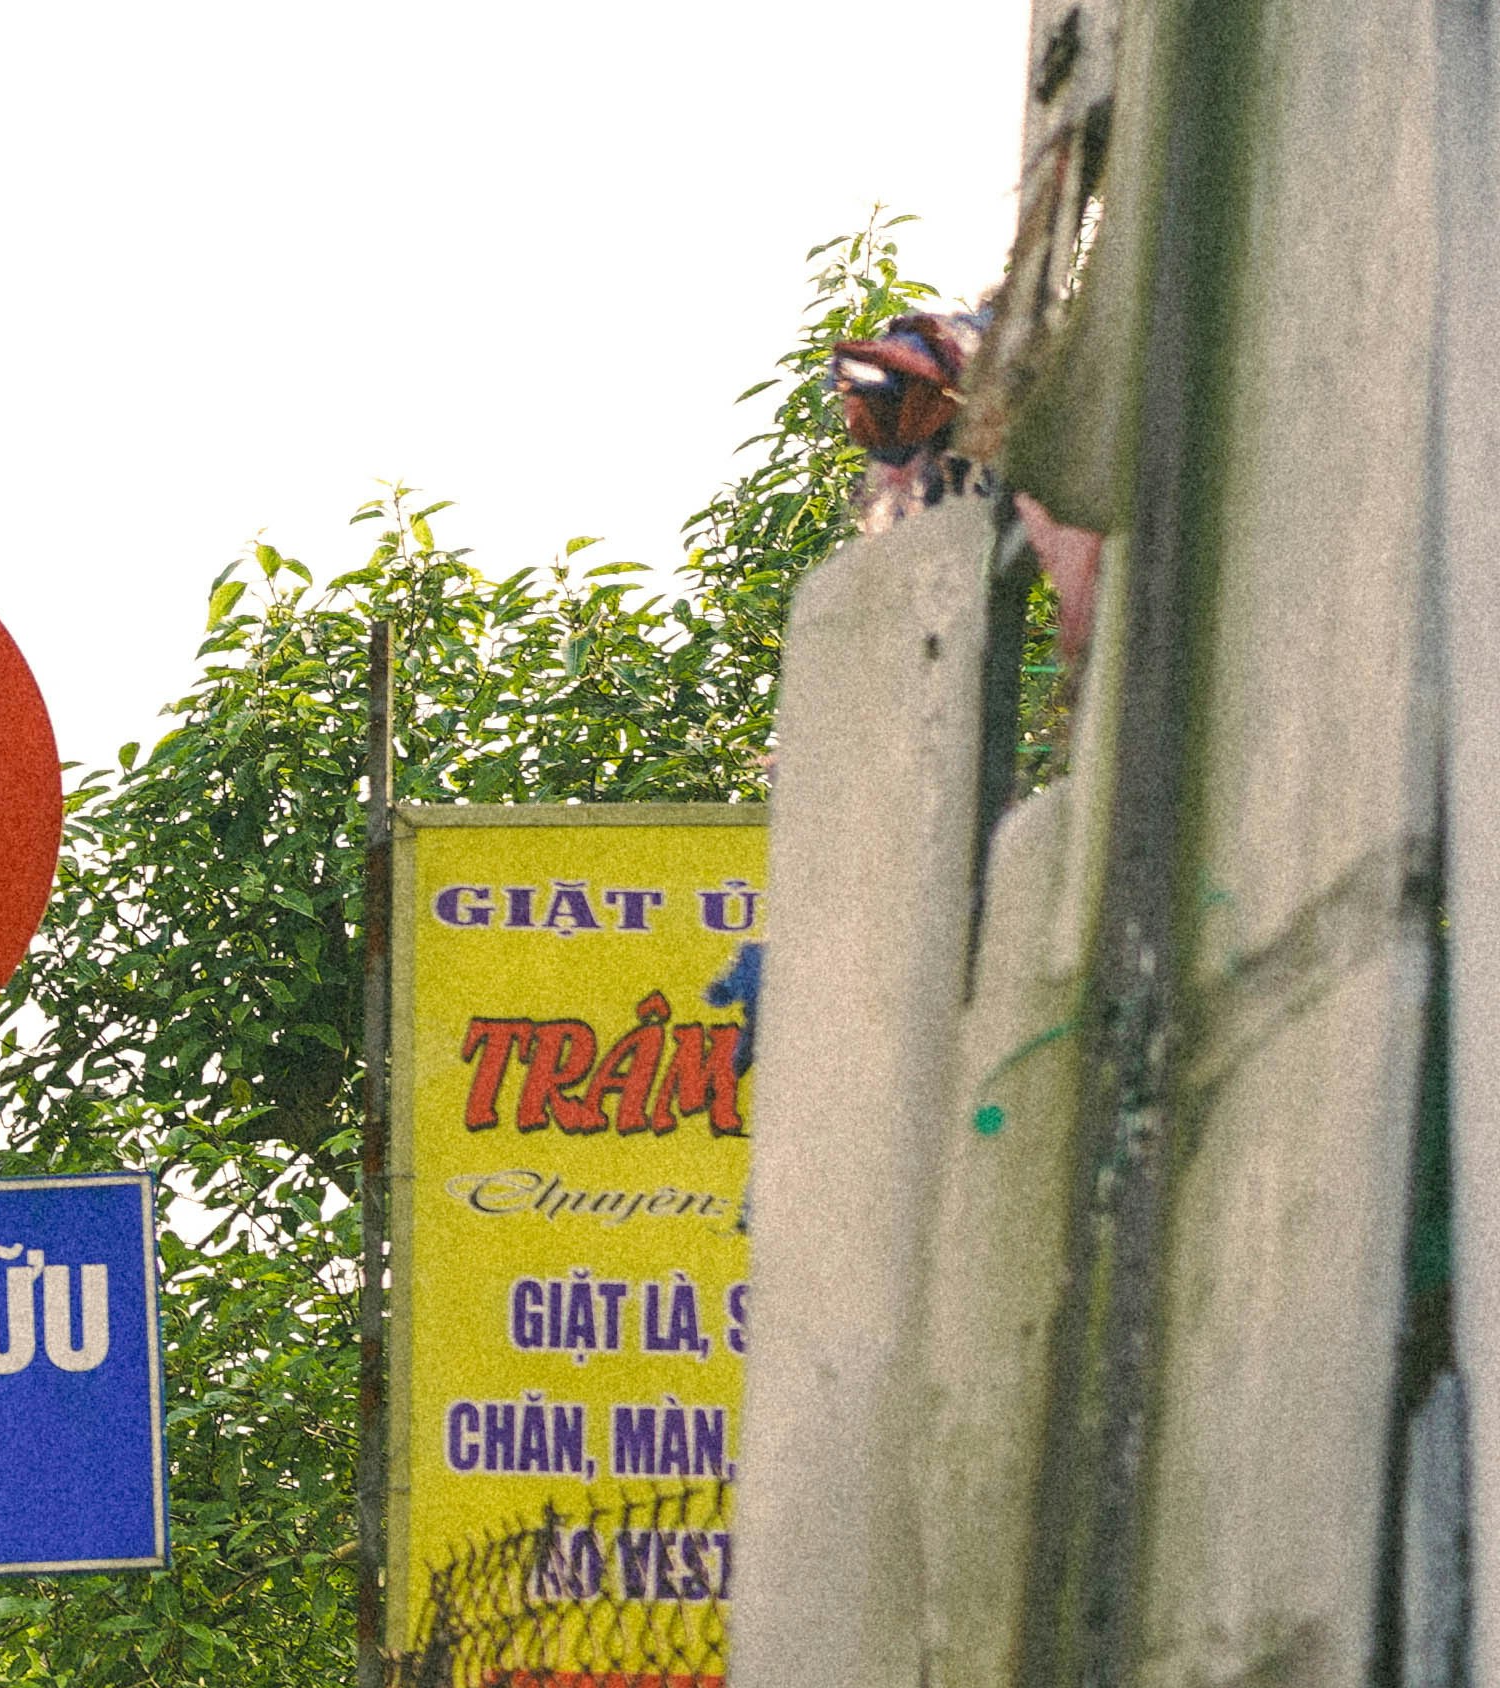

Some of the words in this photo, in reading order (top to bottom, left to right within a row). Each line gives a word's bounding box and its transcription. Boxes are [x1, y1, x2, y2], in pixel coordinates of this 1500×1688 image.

[435, 881, 663, 937] GIẶT
[513, 1270, 628, 1363] GIẶT
[448, 1393, 596, 1479] CHĂN,
